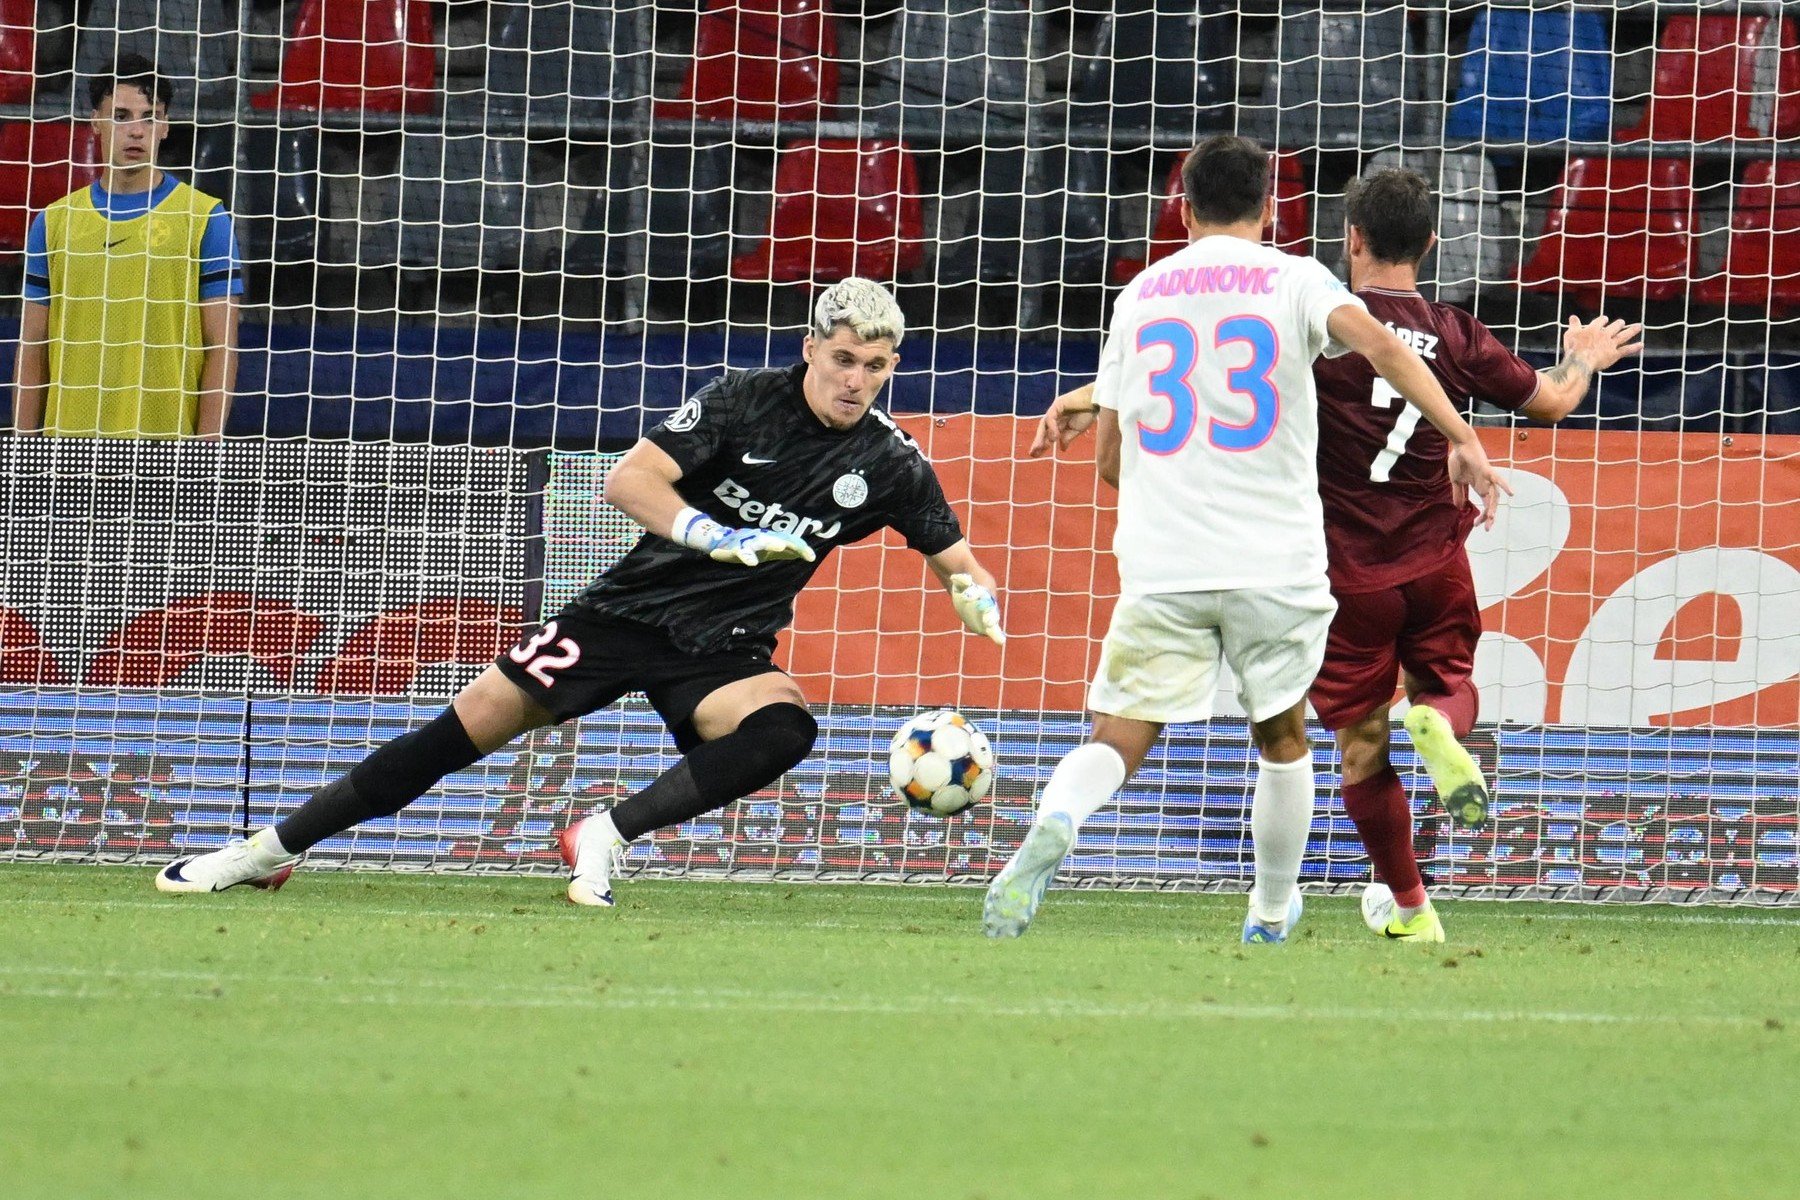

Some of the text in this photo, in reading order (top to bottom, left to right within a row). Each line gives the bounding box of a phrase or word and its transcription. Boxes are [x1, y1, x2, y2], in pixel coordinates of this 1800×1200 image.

[1137, 264, 1280, 301] RADUNOVIC
[1136, 314, 1280, 456] 33
[1370, 376, 1423, 483] 7
[509, 620, 581, 689] 32
